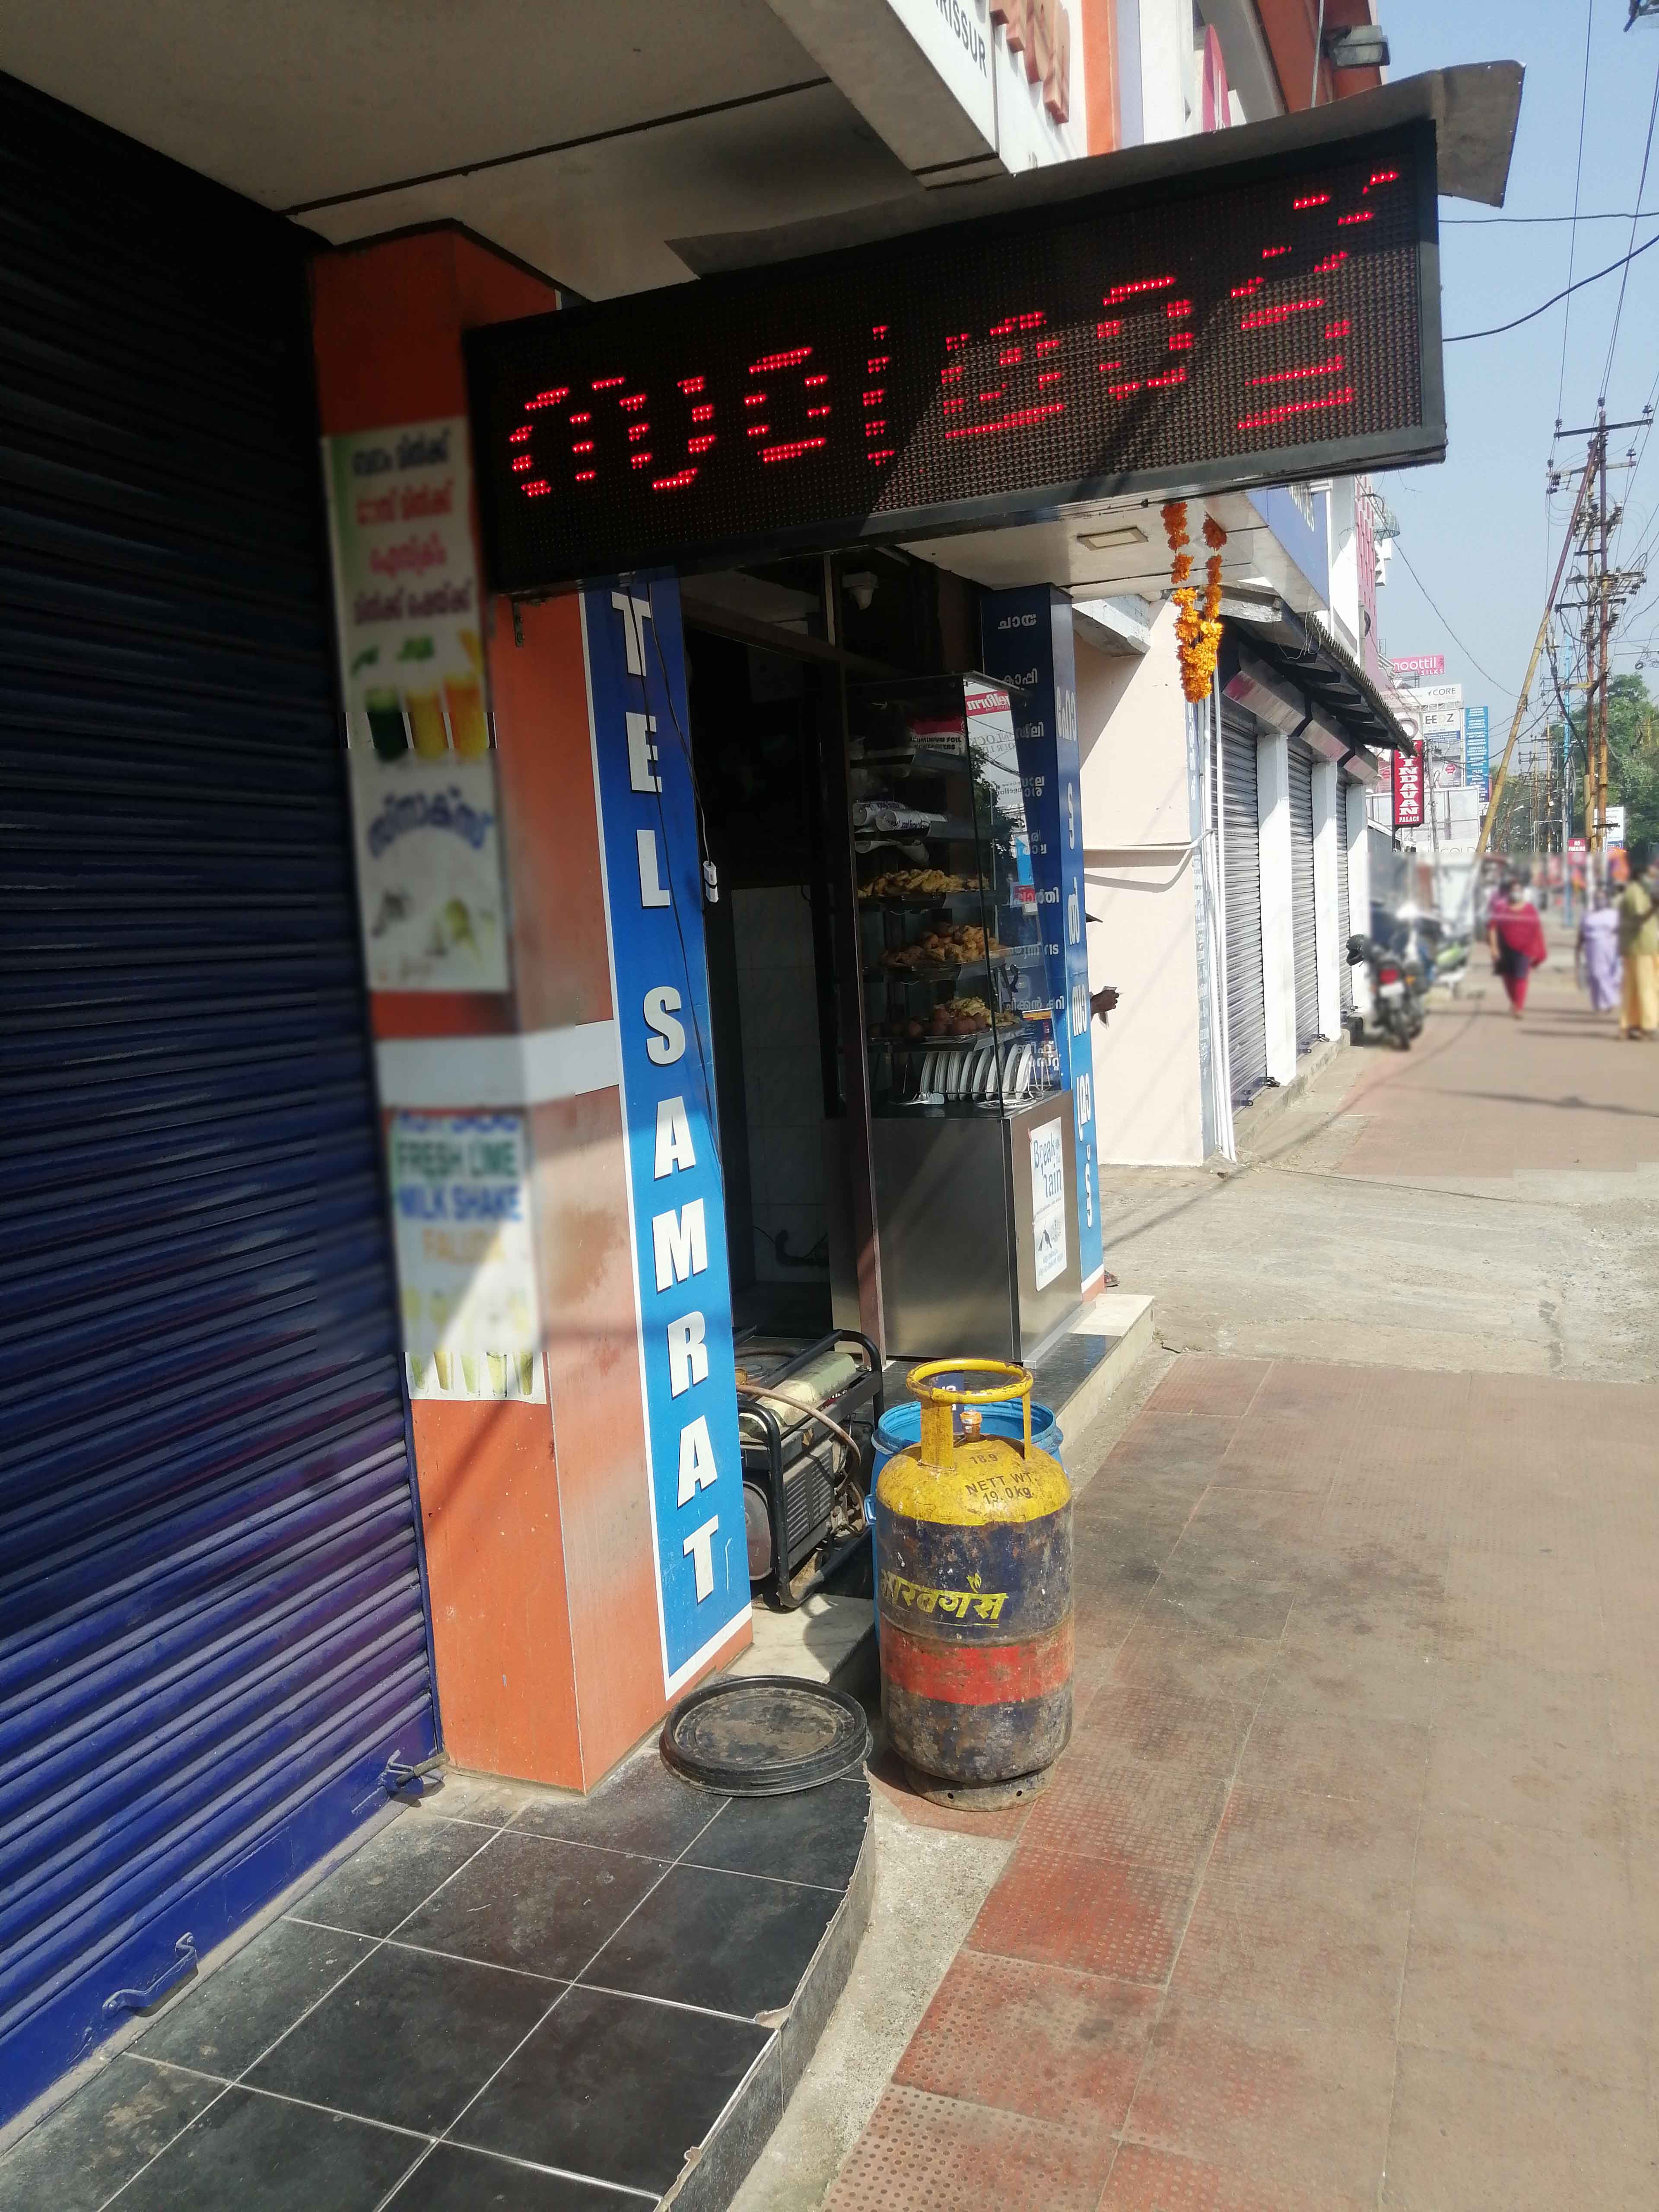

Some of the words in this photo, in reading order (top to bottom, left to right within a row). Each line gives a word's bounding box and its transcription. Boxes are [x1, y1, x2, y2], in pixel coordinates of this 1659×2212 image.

[1033, 1132, 1055, 1170] Break
[642, 985, 720, 1604] SAMRAT
[969, 1453, 998, 1465] 18.9
[965, 1475, 1004, 1495] NETT
[1010, 1471, 1038, 1484] WT.
